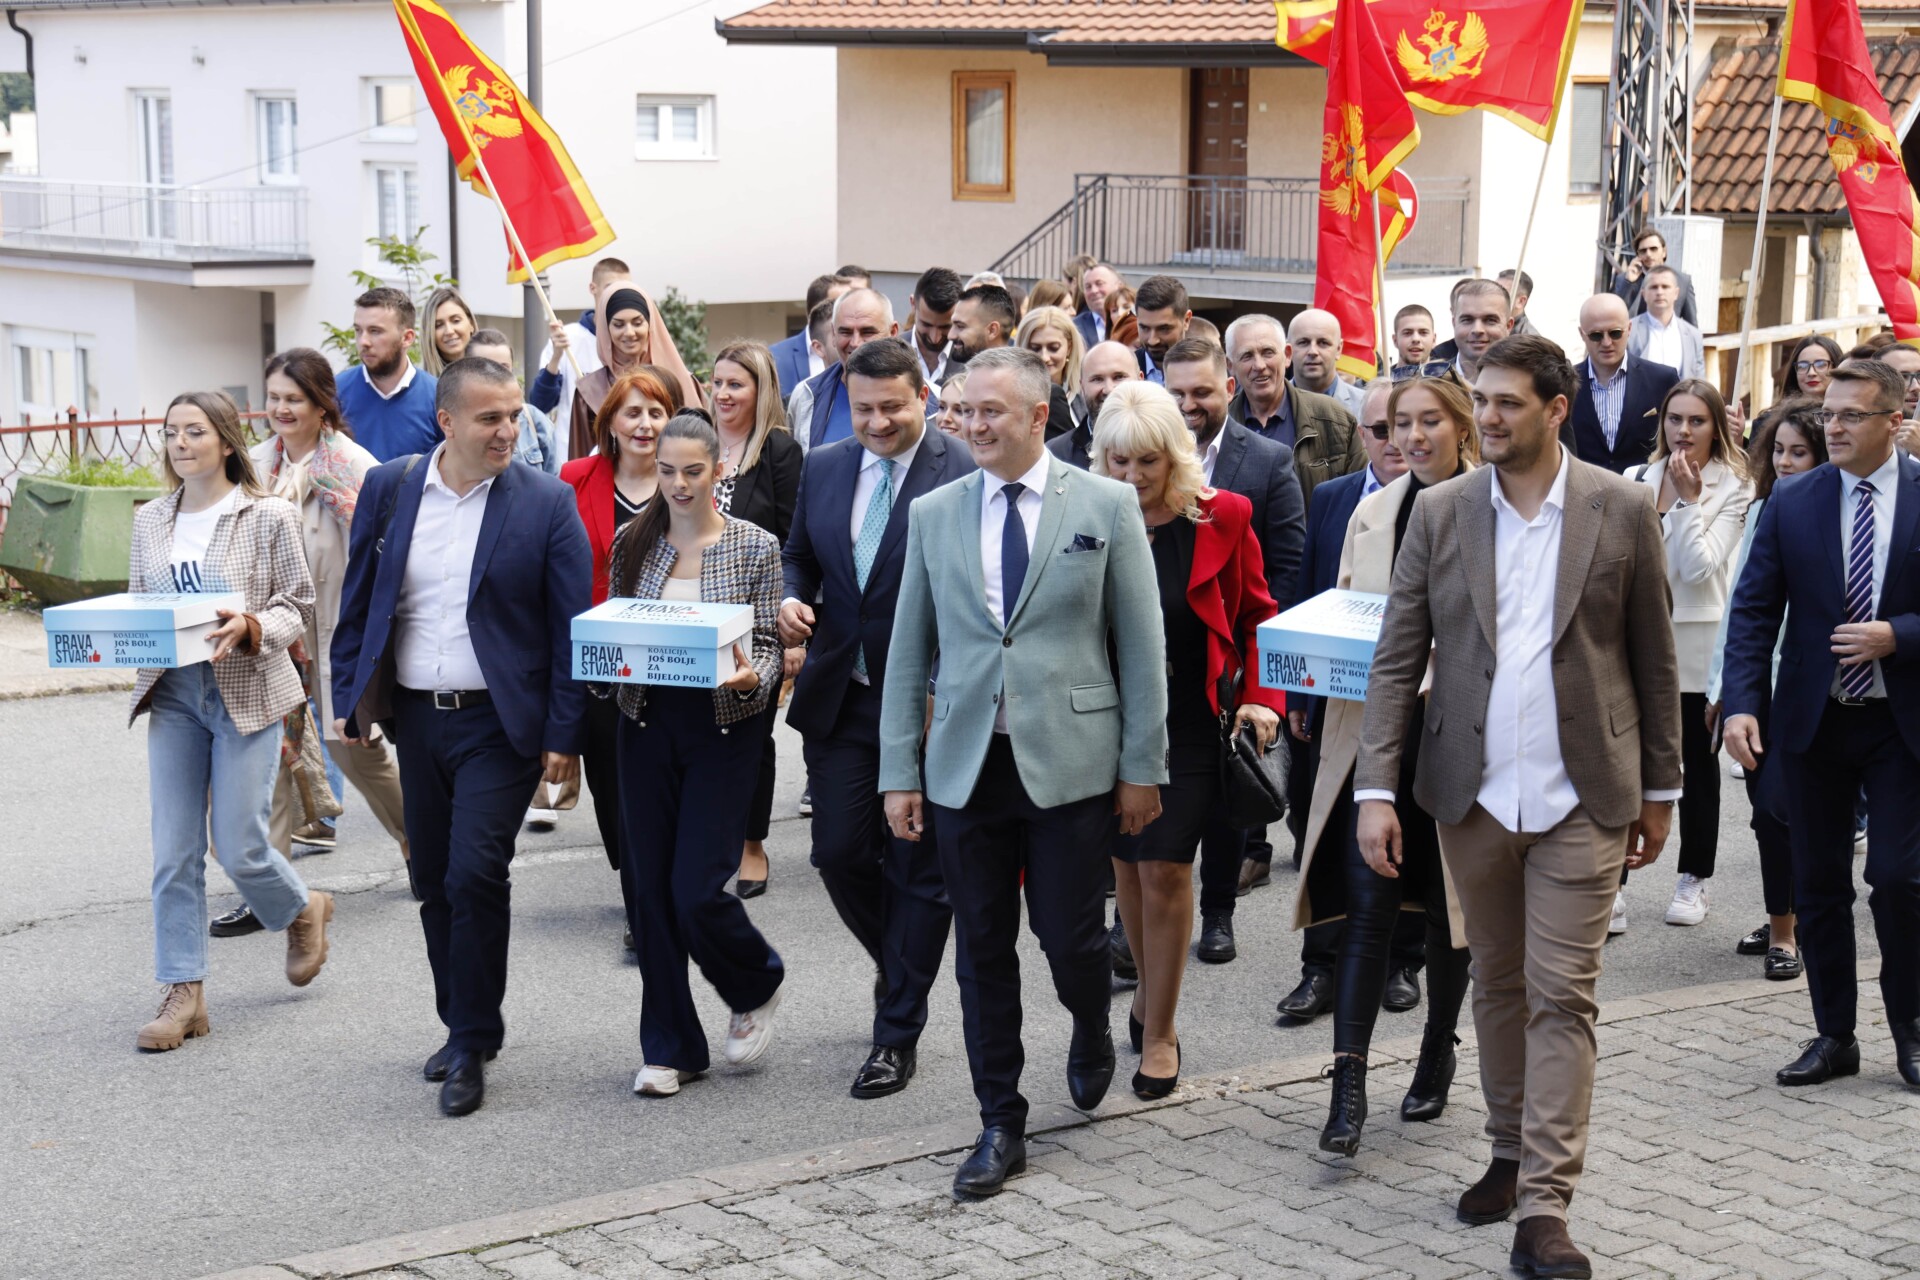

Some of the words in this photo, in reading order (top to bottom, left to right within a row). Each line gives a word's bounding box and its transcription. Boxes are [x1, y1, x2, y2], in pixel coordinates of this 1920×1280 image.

[55, 634, 93, 650] PRAVA
[114, 639, 130, 648] JOŠ
[131, 640, 158, 648] BOLJE
[56, 650, 89, 663] STVAR
[581, 645, 623, 663] PRAVA
[647, 647, 688, 656] KOALICIJA
[115, 657, 145, 665] BIJELO
[146, 657, 173, 665] POLJE
[648, 654, 665, 663] JOŠ
[667, 656, 697, 665] BOLJE
[1267, 652, 1307, 673] PRAVA
[1329, 658, 1368, 670] KOALICIJA
[581, 661, 617, 677] STVAR
[647, 663, 660, 671] ZA
[1329, 666, 1347, 676] JOŠ
[1348, 669, 1369, 679] BOL
[647, 672, 680, 682] BIJELO
[682, 675, 711, 683] POLJE
[1267, 668, 1302, 686] STVAR
[1329, 675, 1342, 684] ZA
[1329, 685, 1362, 696] BIJELO
